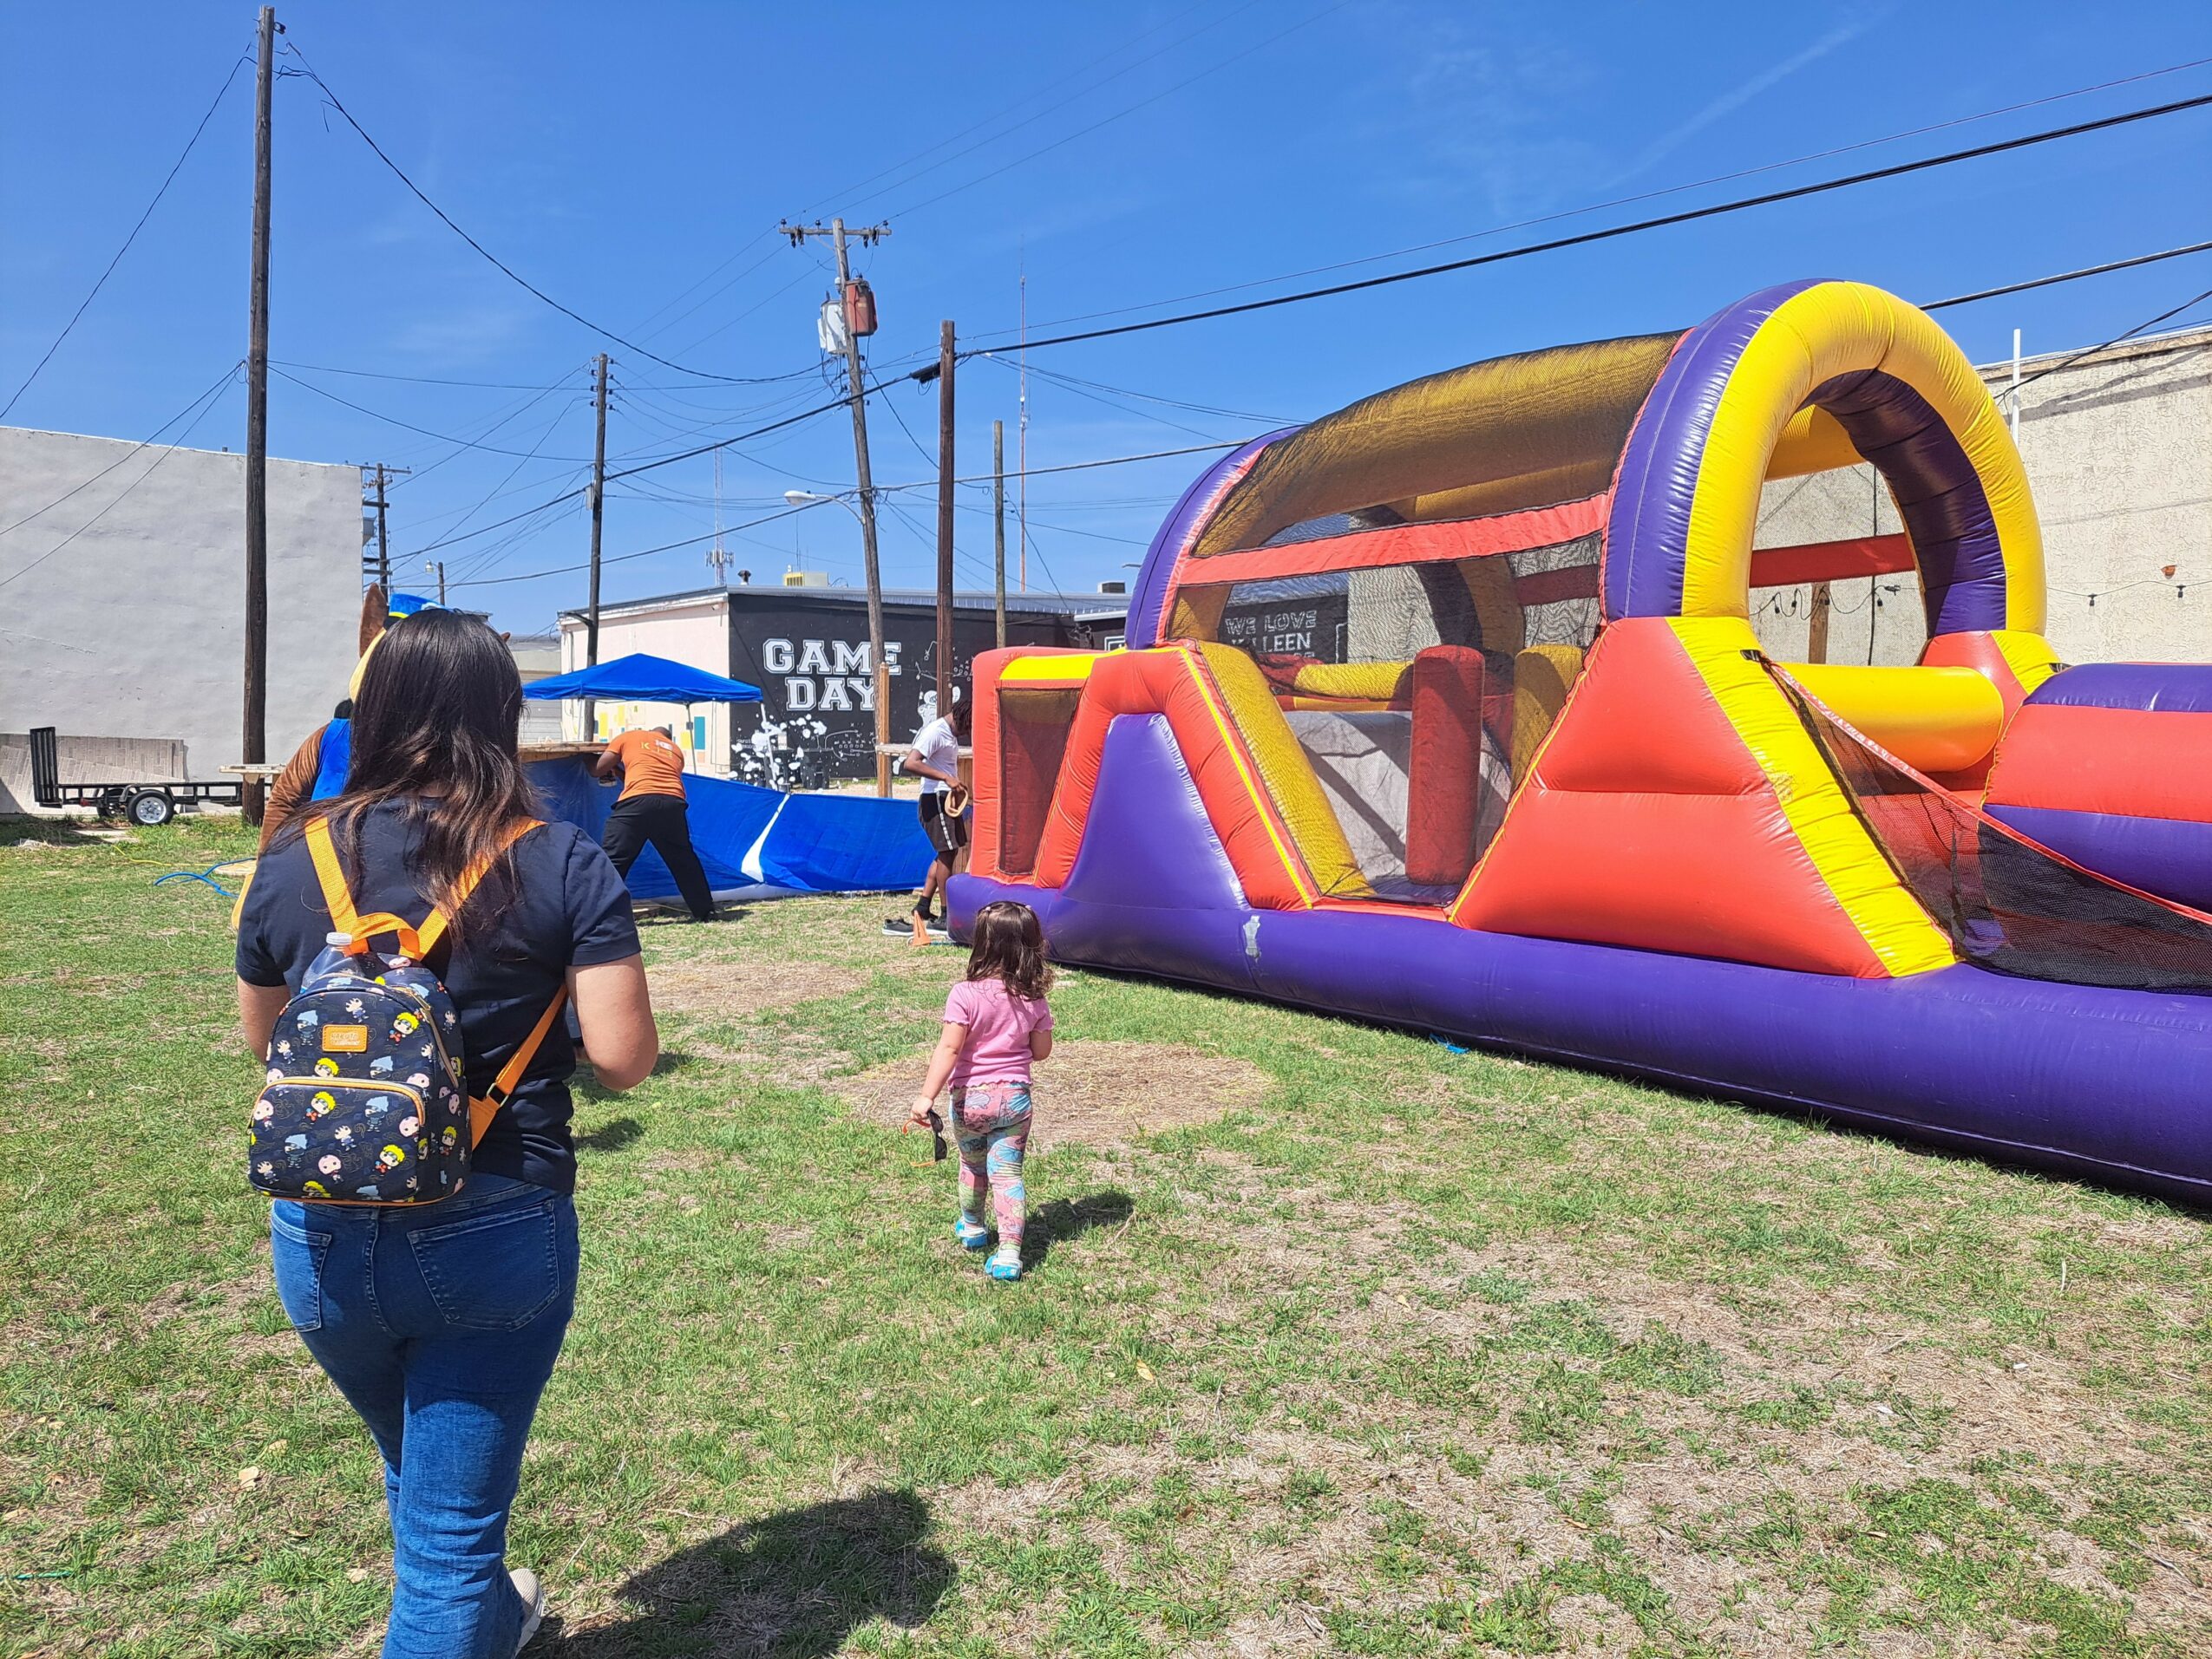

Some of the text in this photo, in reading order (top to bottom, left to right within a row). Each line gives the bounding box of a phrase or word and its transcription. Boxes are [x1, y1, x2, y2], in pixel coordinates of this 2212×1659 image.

[1225, 610, 1317, 635] WE LOVE
[762, 638, 901, 676] GAME
[785, 676, 874, 711] DAY
